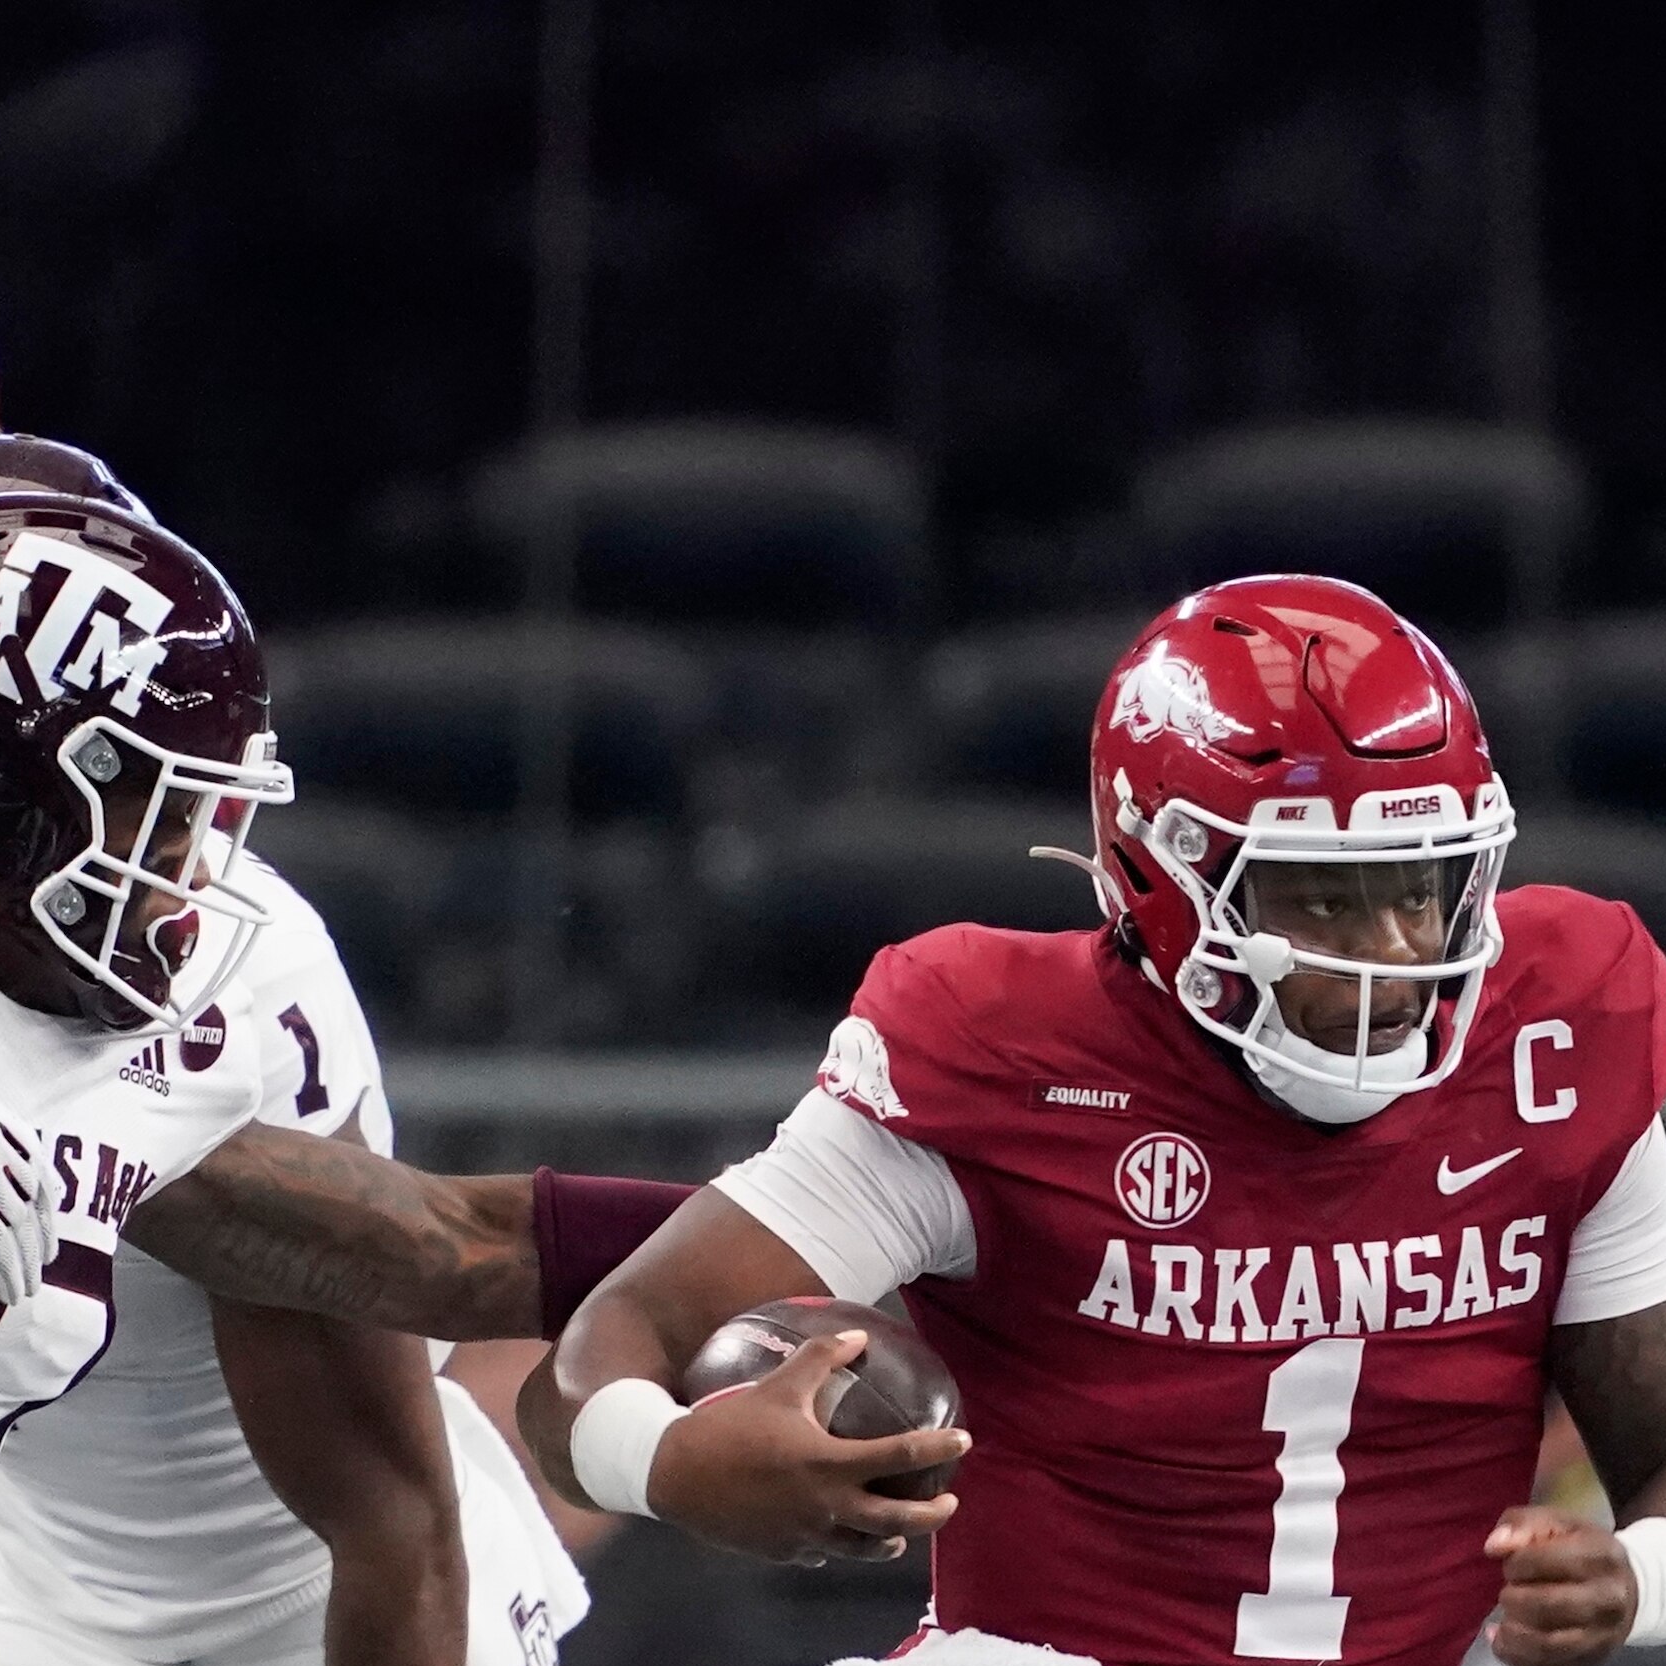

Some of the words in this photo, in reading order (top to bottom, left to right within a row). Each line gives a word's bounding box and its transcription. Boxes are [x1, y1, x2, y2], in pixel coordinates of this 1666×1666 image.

[1275, 804, 1308, 822] NIKE
[1381, 795, 1441, 819] HOGS
[119, 1065, 171, 1097] adidas
[1044, 1086, 1131, 1110] EQUALITY
[1515, 1019, 1578, 1124] C
[1121, 1142, 1205, 1223] SEC
[1077, 1215, 1548, 1344] ARKANSAS
[1233, 1338, 1366, 1662] 1
